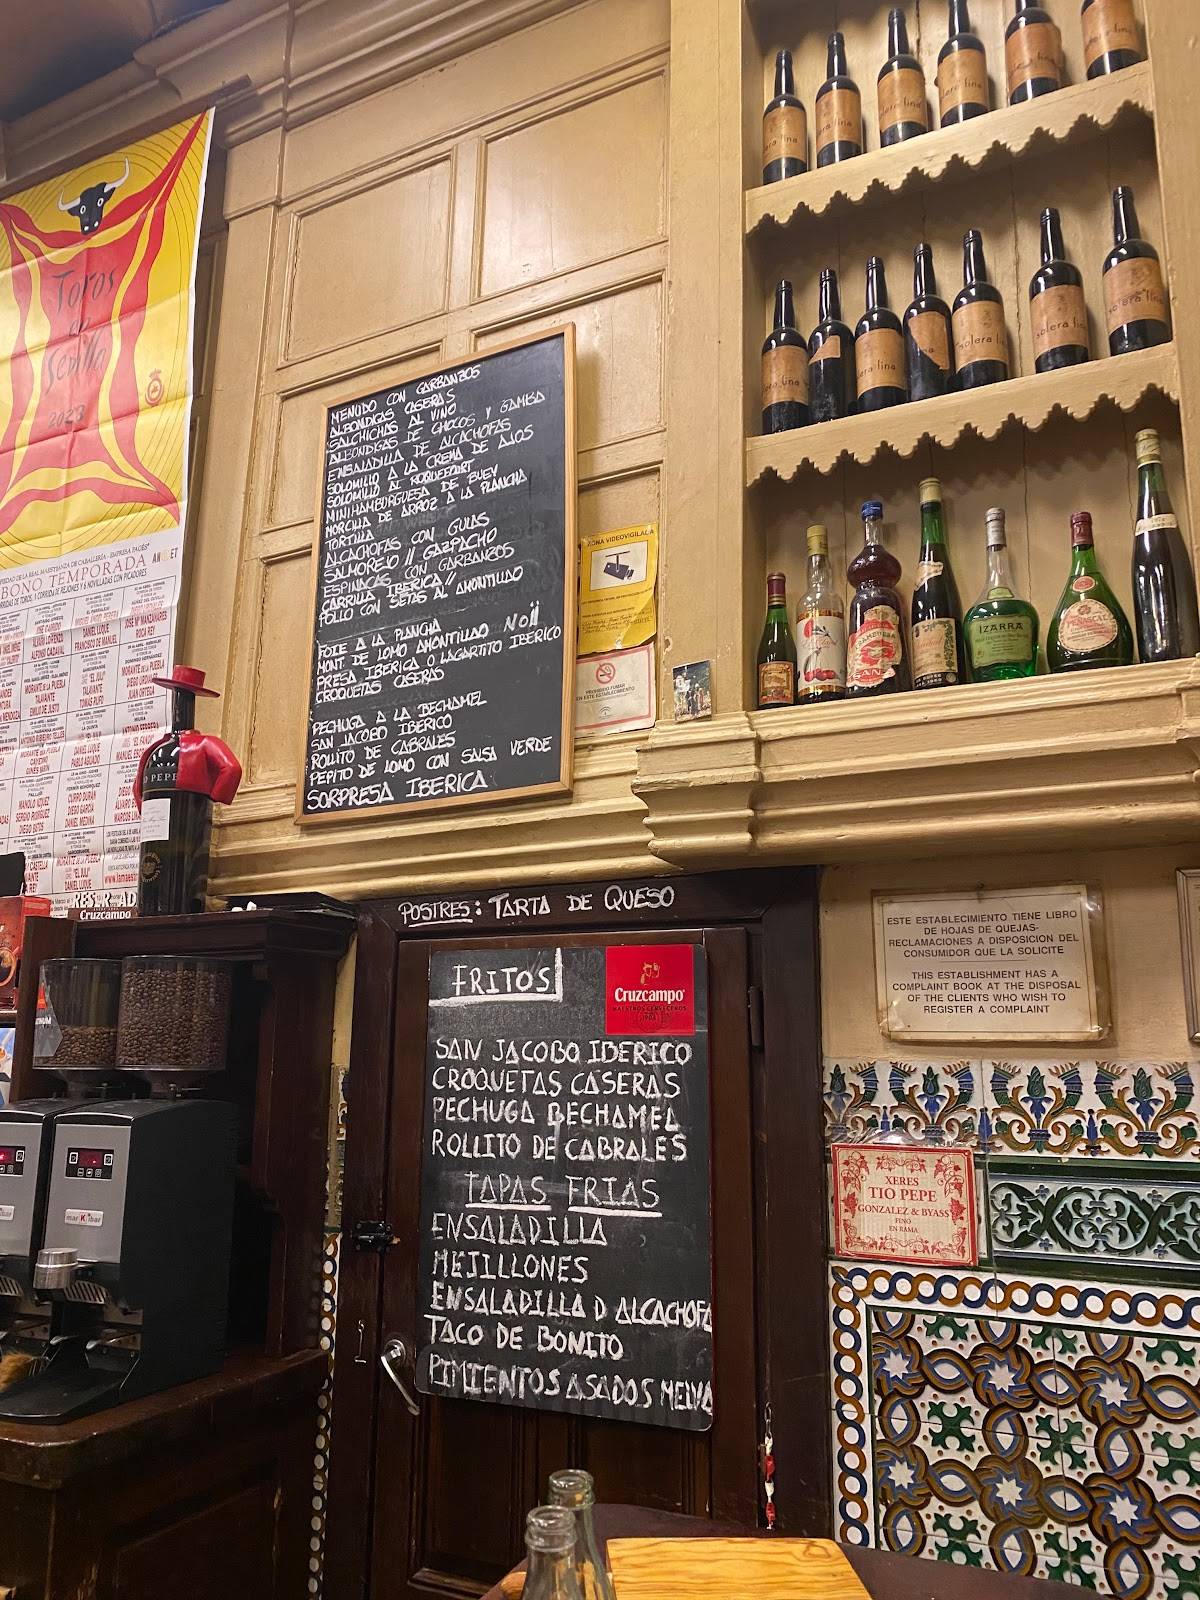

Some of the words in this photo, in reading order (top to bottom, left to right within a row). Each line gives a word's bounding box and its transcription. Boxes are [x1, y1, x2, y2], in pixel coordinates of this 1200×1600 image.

[331, 400, 377, 424] MENUDO
[386, 390, 405, 405] CON
[416, 365, 480, 394] GARBANZOS
[328, 421, 398, 449] SALCHICHAS
[408, 414, 424, 428] AL
[431, 403, 457, 422] VINO
[329, 409, 394, 438] ALBONDIGAS
[405, 389, 455, 414] CASERAS
[329, 436, 398, 465] ALBONDIGAS
[404, 428, 420, 443] DE
[431, 414, 475, 435] CHOCOS
[486, 407, 491, 418] Y
[500, 391, 545, 412] GAMBA
[328, 450, 404, 482] ENSALADILLA
[414, 443, 429, 458] DE
[439, 419, 512, 448] ALCACHOFAS
[324, 555, 398, 582] SALMOREJO
[423, 527, 498, 561] GAZPACHO
[325, 538, 401, 568] ALCACHOFAS
[411, 528, 435, 545] CON
[448, 512, 489, 536] GULAS
[325, 531, 374, 551] TORTILLA
[324, 574, 391, 597] ESPINACAS
[405, 562, 428, 579] CON
[439, 546, 514, 570] GARBANZOS
[318, 642, 347, 659] FOIE
[356, 638, 367, 649] A
[371, 636, 385, 647] LA
[394, 619, 441, 642] PLANCHA
[980, 622, 1024, 634] IZARRA
[317, 671, 357, 690] PRESA
[365, 657, 420, 680] IBERICA
[427, 654, 435, 666] O
[441, 641, 502, 665] LAGARTITO
[509, 624, 561, 649] IBERICO
[315, 681, 381, 704] CROQUETAS
[393, 669, 444, 688] CASERAS
[312, 716, 365, 735] PECHUGA
[376, 711, 386, 723] A
[394, 707, 410, 721] LA
[418, 691, 487, 718] BECHAMEL
[311, 749, 355, 770] ROLLITO
[365, 745, 381, 760] DE
[391, 731, 456, 755] CABRALES
[312, 737, 333, 752] SAN
[341, 726, 387, 747] JACOBO
[398, 715, 452, 736] IBERICO
[307, 782, 394, 810] SORPRESA
[406, 770, 488, 798] IBERICA
[488, 894, 551, 919] TARTA
[566, 895, 593, 912] DE
[604, 885, 674, 910] QUESO
[887, 917, 911, 925] ESTE
[915, 913, 1007, 924] ESTABLECIMIENTO
[1012, 912, 1041, 920] TIENE
[1046, 910, 1077, 919] LIBRO
[889, 937, 973, 947] RECLAMACIONES
[989, 935, 1053, 945] DISPOSICION
[1059, 933, 1079, 942] DEL
[924, 926, 937, 935] DE
[941, 925, 974, 935] HOJAS
[978, 924, 992, 933] DE
[996, 923, 1040, 933] QUEJAS-
[903, 948, 970, 958] CONSUMIDOR
[975, 947, 996, 957] QUE
[1001, 947, 1014, 955] LA
[1018, 946, 1064, 955] SOLICITE
[452, 964, 551, 995] FRITOS
[892, 982, 949, 991] COMPLAINT
[953, 982, 982, 991] BOOK
[987, 981, 1000, 990] AT
[1005, 980, 1025, 989] THE
[1029, 980, 1080, 989] DISPOSAL
[912, 971, 934, 979] THIS
[937, 970, 1021, 979] ESTABLISHMENT
[1025, 969, 1047, 978] HAS
[1051, 969, 1058, 977] A
[614, 987, 685, 1003] Cruzcampo
[907, 994, 921, 1002] OF
[925, 994, 944, 1002] THE
[947, 993, 989, 1002] CLIENTS
[992, 993, 1018, 1001] WHO
[1022, 992, 1048, 1001] WISH
[1052, 992, 1066, 1000] TO
[924, 1005, 973, 1014] REGISTER
[978, 1005, 985, 1013] A
[990, 1004, 1049, 1013] COMPLAINT
[436, 1038, 482, 1060] SAN
[492, 1039, 580, 1064] JACOBO
[587, 1039, 692, 1065] IBERICO
[432, 1067, 561, 1096] CROQUETAS
[570, 1071, 681, 1098] CASERAS
[433, 1096, 535, 1124] PECHUGA
[431, 1129, 521, 1159] ROLLITO
[533, 1136, 555, 1160] DE
[565, 1133, 687, 1162] CABRALES
[465, 1171, 547, 1204] TAPAS
[565, 1175, 660, 1208] FRIAS
[868, 1187, 896, 1199] TIO
[900, 1189, 937, 1201] PEPE
[885, 1176, 919, 1186] XERES
[858, 1204, 908, 1215] GONZALEZ
[922, 1209, 950, 1217] BYASS
[431, 1213, 607, 1246] ENSALADILLA
[432, 1249, 589, 1284] MEJILLONES
[430, 1281, 586, 1318] ENSALADILLA
[424, 1314, 484, 1346] TACO
[496, 1322, 523, 1350] DE
[537, 1325, 624, 1360] BONITO
[429, 1353, 561, 1400] PIMIENTOS
[565, 1373, 654, 1409] ASADOS
